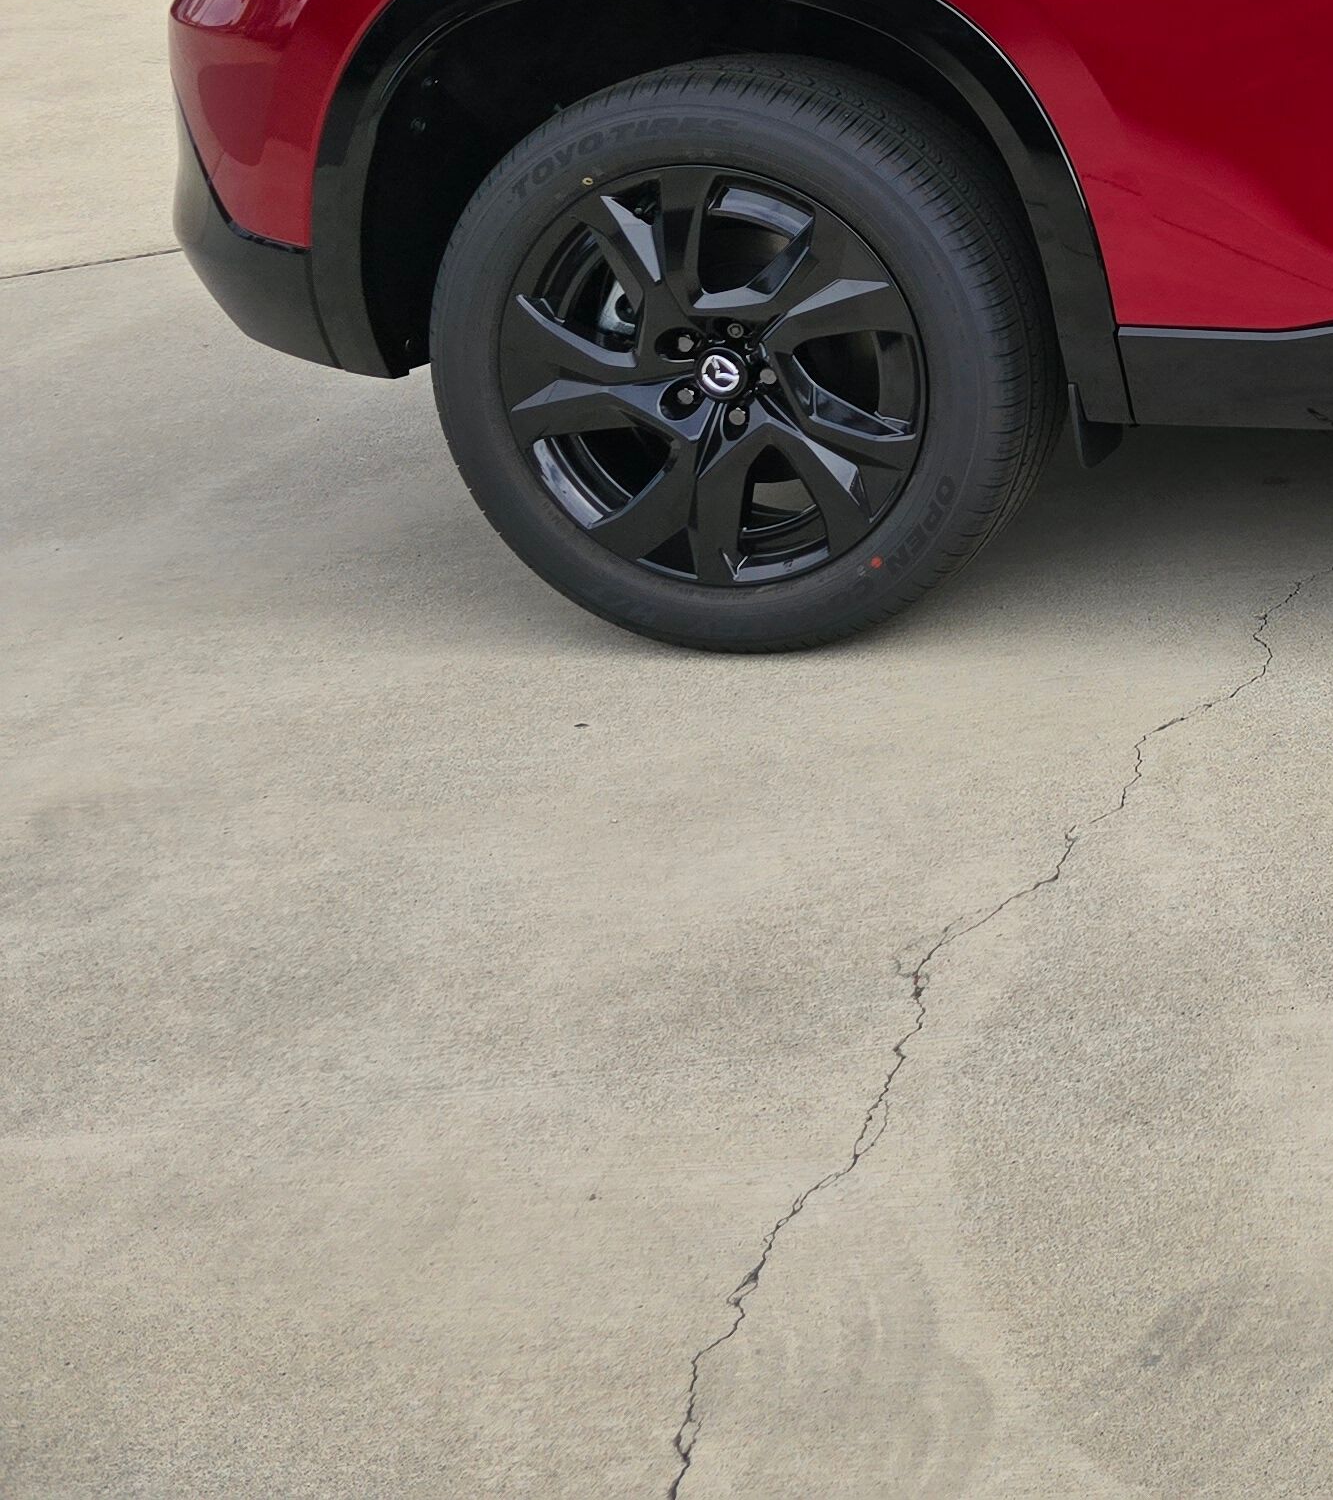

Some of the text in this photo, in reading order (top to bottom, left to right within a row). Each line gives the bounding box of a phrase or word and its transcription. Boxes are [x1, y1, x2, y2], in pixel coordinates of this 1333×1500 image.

[510, 115, 742, 199] TOYO TIRES
[886, 475, 955, 574] OPEN
